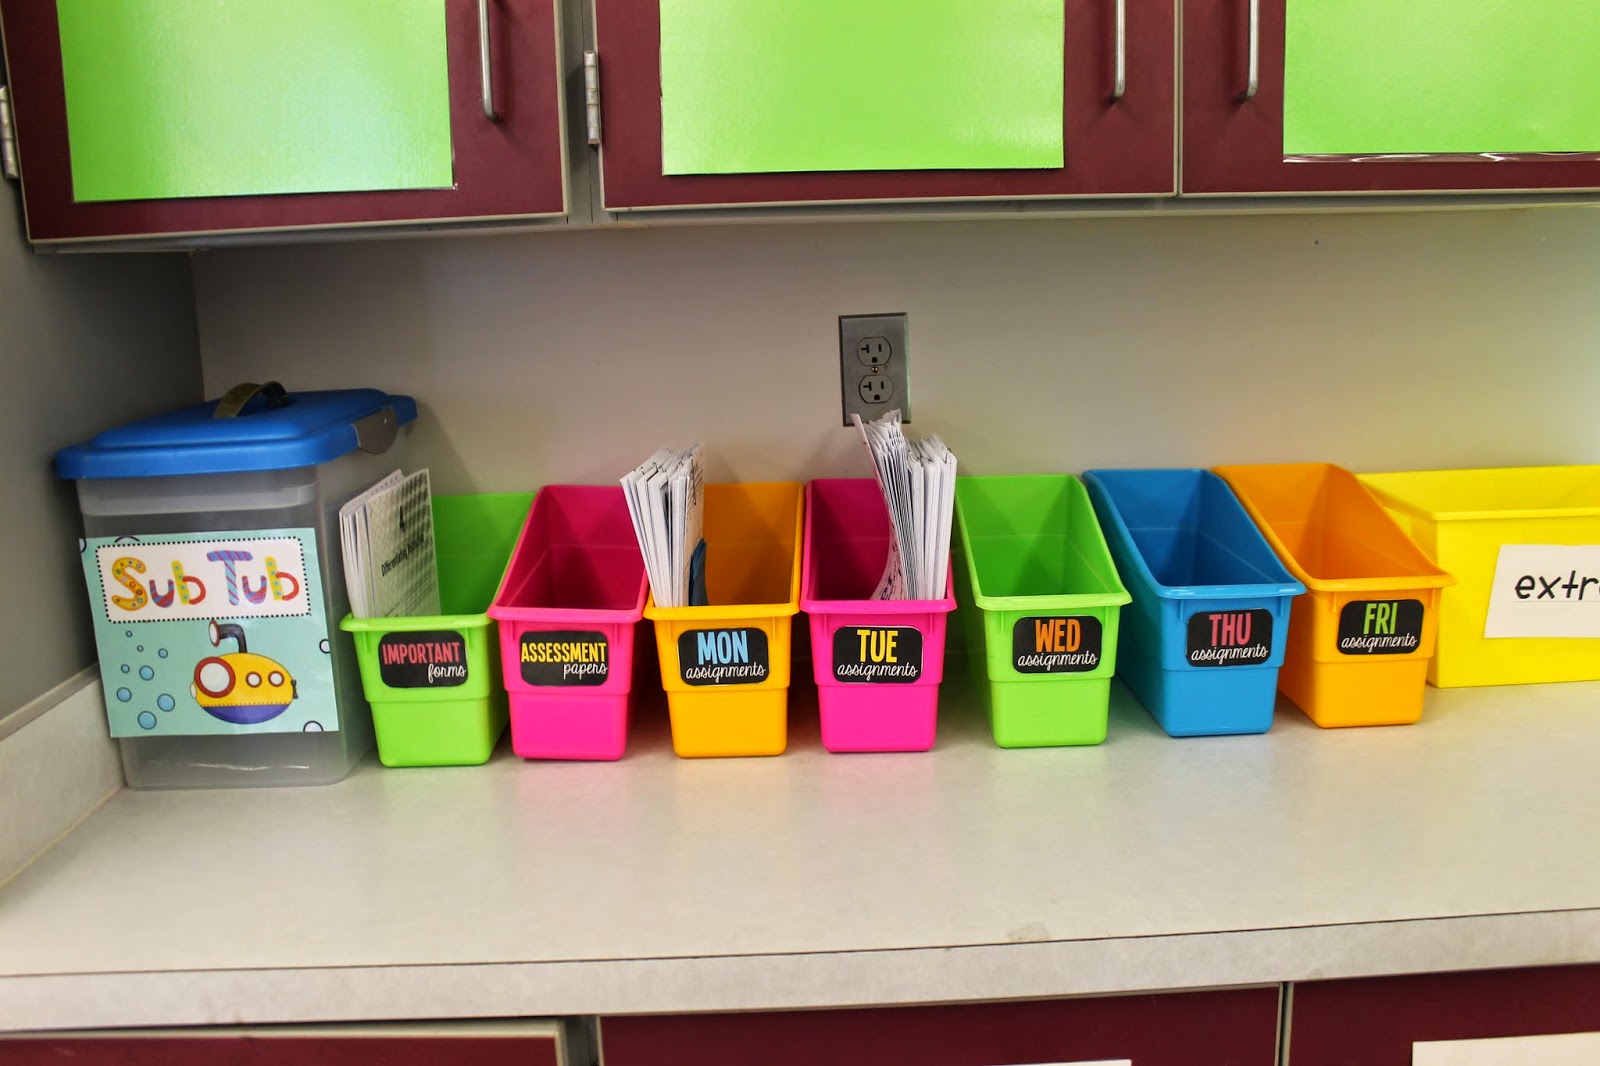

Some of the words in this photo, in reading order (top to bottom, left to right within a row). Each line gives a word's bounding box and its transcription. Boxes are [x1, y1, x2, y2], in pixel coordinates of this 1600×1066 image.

[111, 556, 207, 611] Sub
[206, 549, 300, 606] Tub
[1514, 569, 1600, 601] extr
[1208, 612, 1252, 647] THU
[1363, 602, 1398, 635] FRI
[856, 629, 898, 663] TUE
[1035, 618, 1081, 653] WED
[1341, 632, 1417, 653] assignments
[382, 641, 461, 665] IMPORTANT
[521, 642, 607, 663] ASSESSMENT
[697, 631, 749, 665] MON
[1191, 642, 1269, 665] assignments
[563, 661, 608, 680] papers
[1017, 649, 1098, 671] assignments
[427, 662, 467, 683] forms
[685, 662, 767, 683] assignments
[837, 662, 919, 682] assignments
